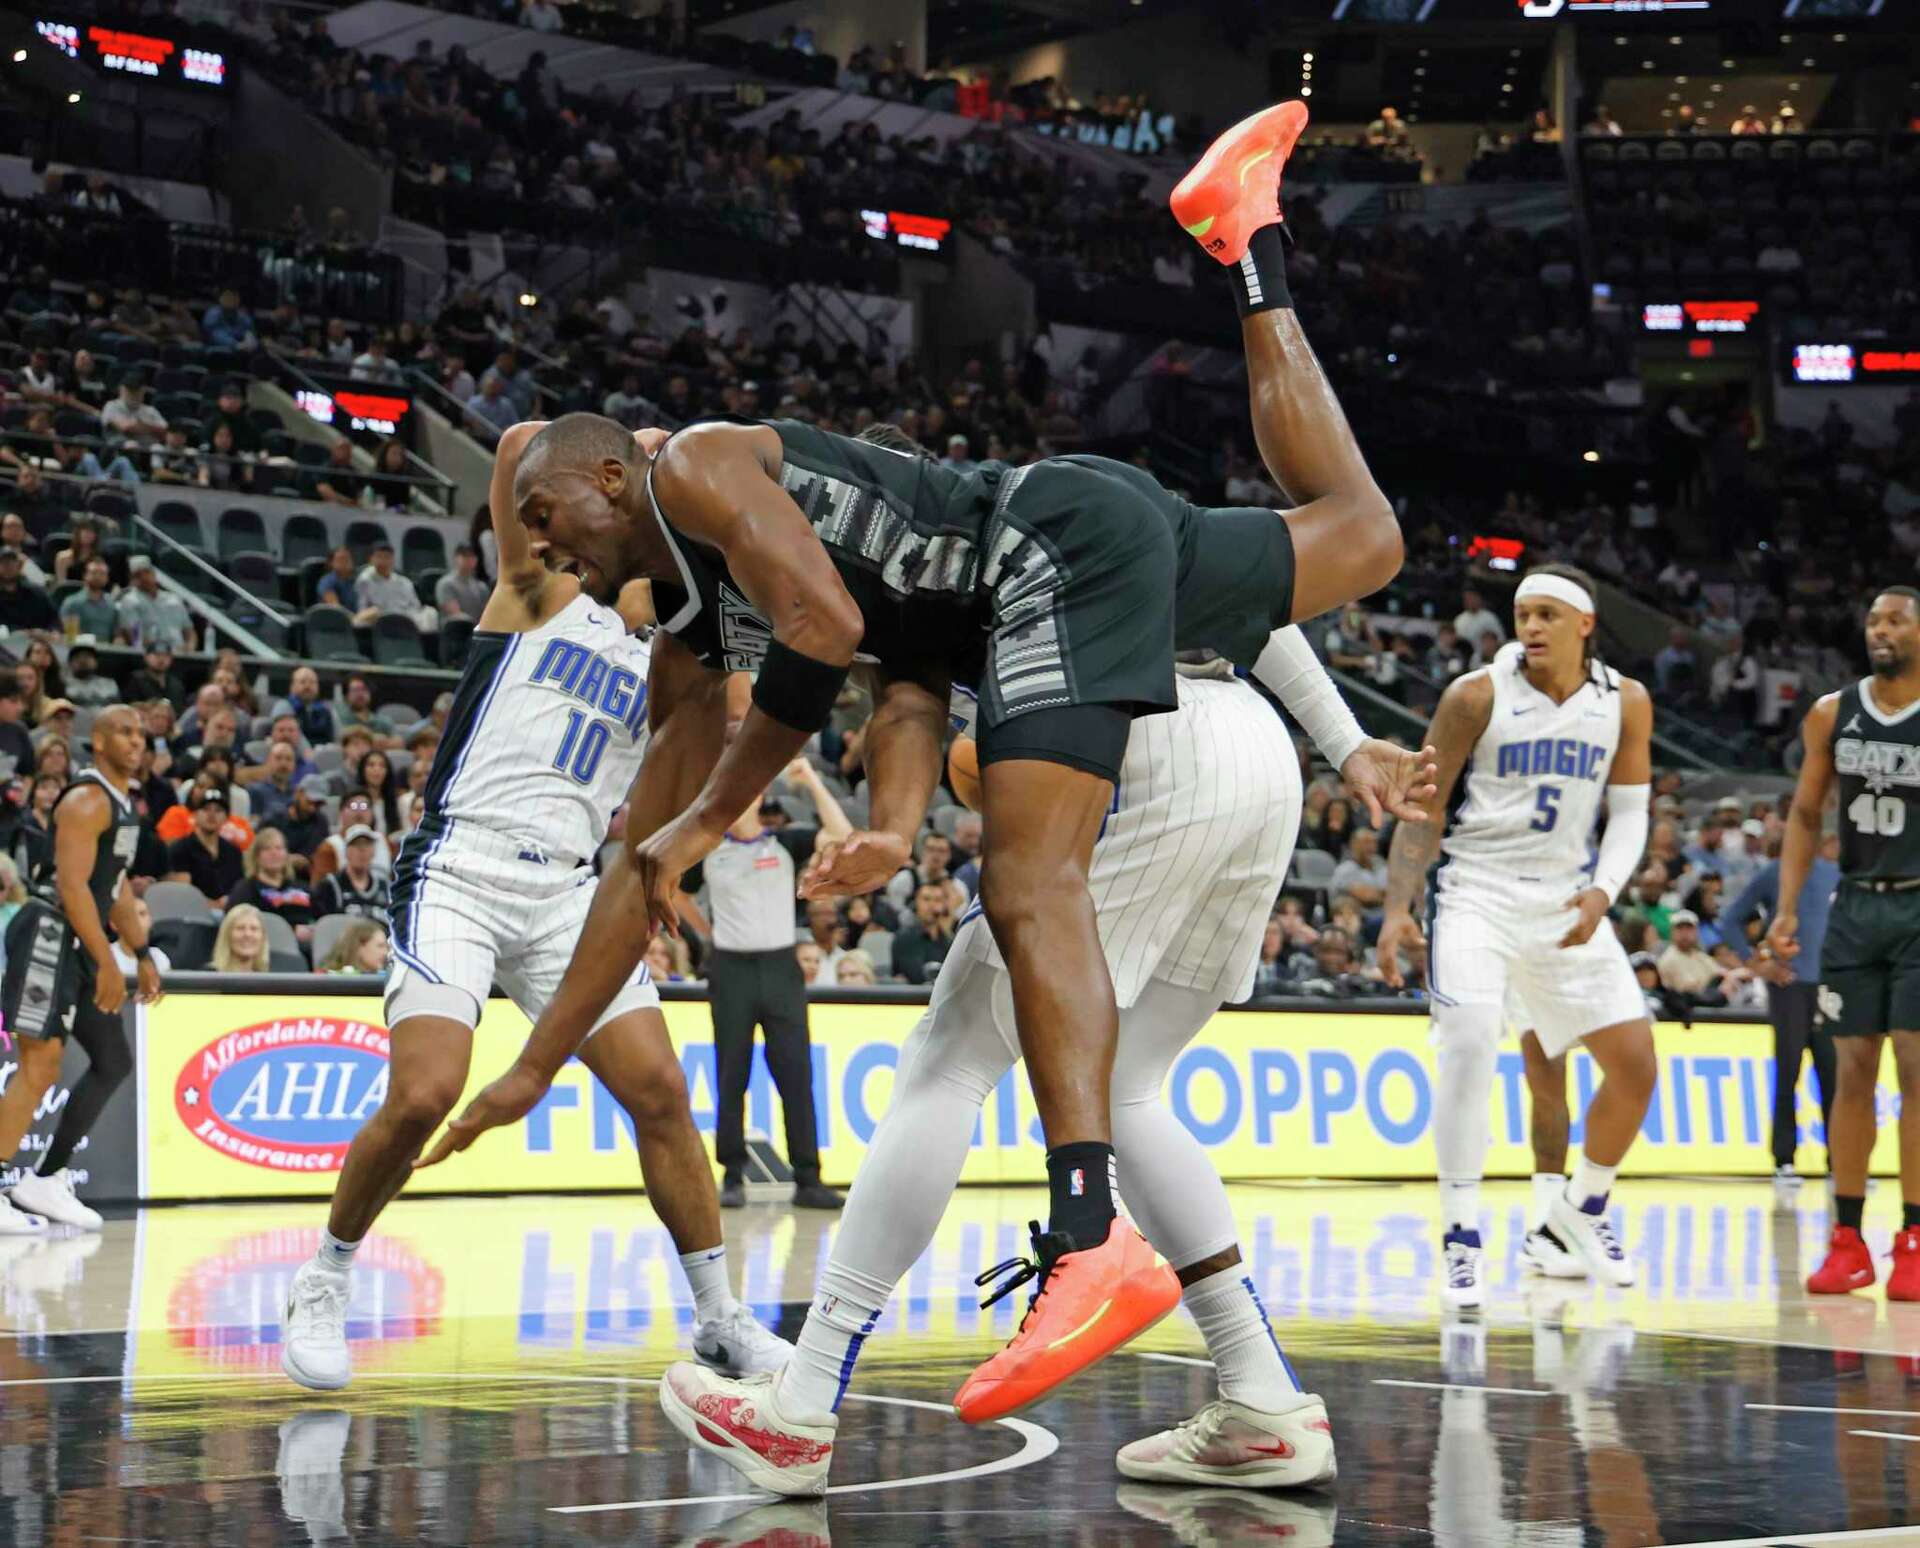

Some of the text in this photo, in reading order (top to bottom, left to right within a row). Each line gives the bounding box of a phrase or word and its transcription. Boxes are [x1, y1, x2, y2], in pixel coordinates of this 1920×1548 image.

[552, 707, 611, 785] 10
[1497, 738, 1607, 783] MAGIC
[1529, 784, 1562, 833] 5
[1848, 793, 1906, 837] 40
[202, 1018, 391, 1081] Affordable Hea
[225, 1060, 391, 1121] AHIA
[194, 1118, 335, 1170] Insurance
